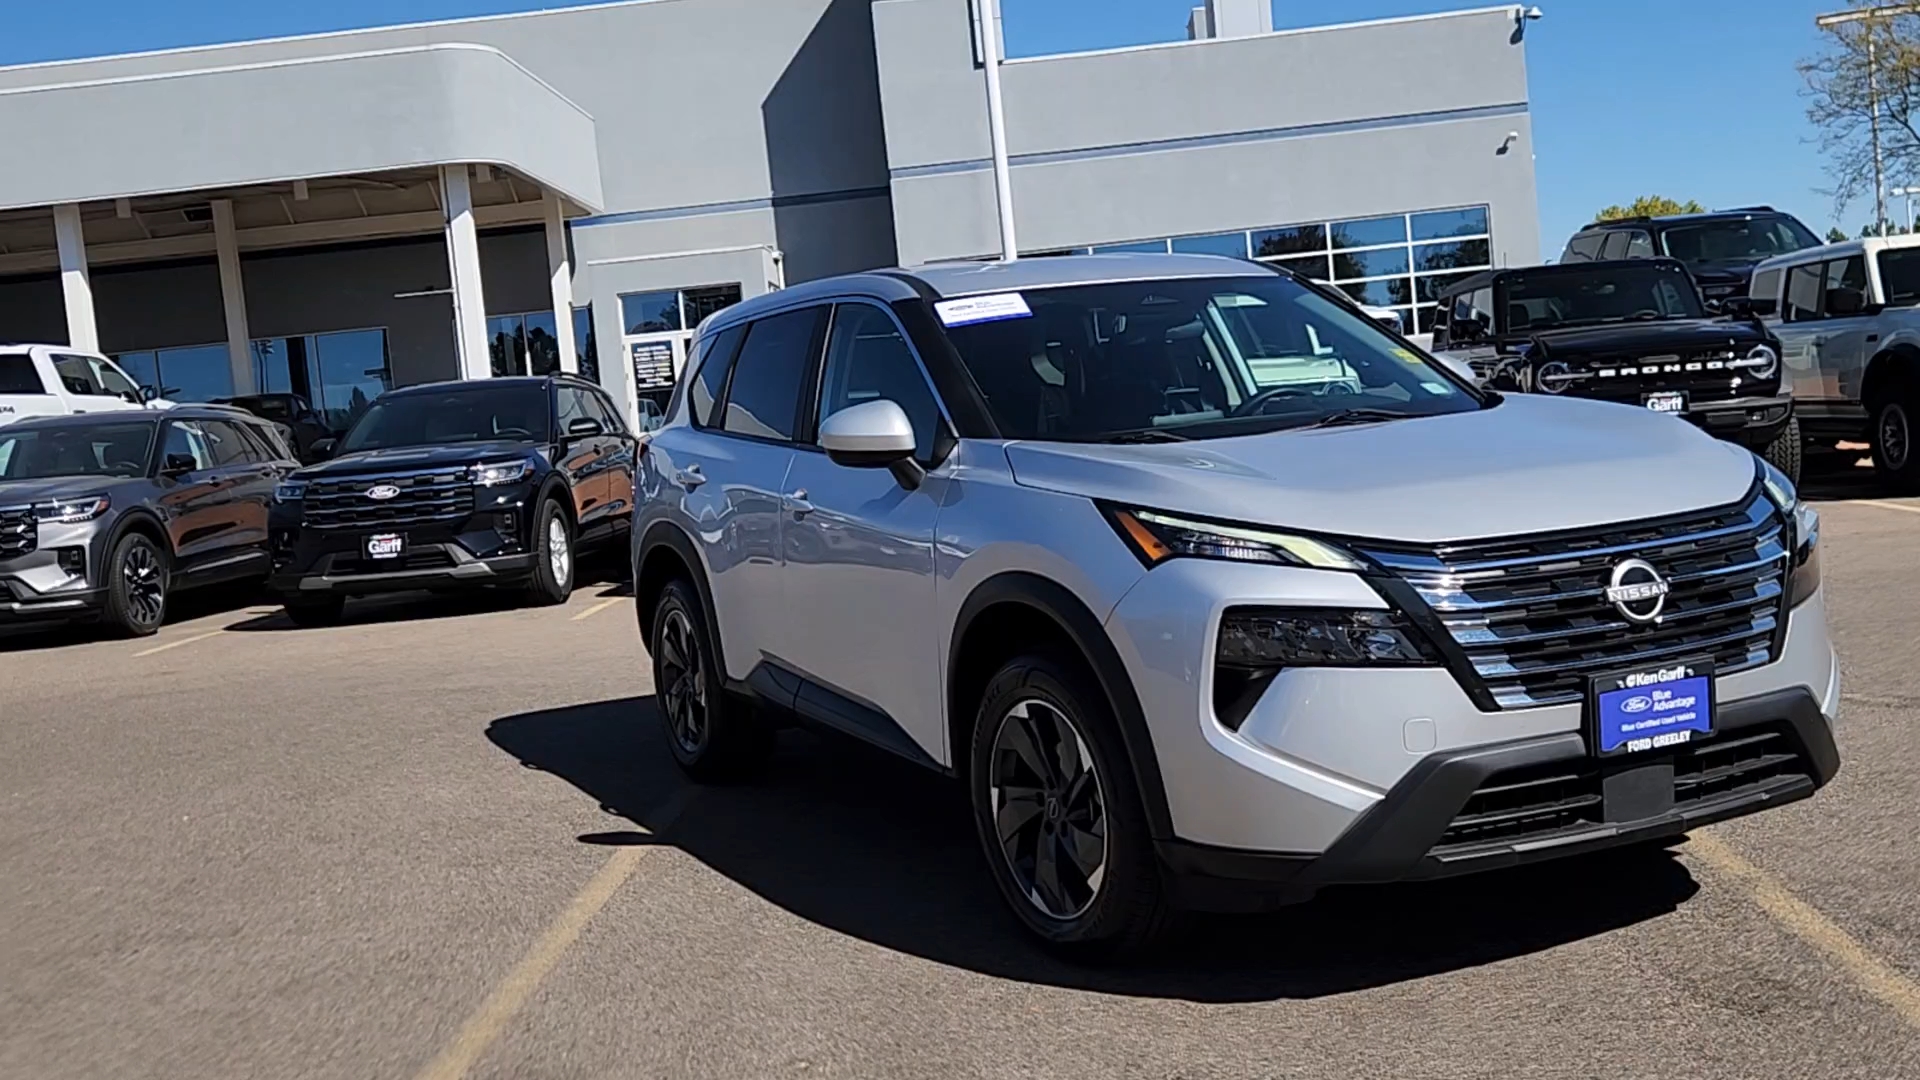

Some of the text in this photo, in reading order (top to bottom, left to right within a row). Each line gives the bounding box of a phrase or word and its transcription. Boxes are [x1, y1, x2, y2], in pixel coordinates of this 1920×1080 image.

[1599, 361, 1723, 377] BRONCO
[1647, 396, 1683, 412] Garff
[368, 538, 402, 554] Garff
[1607, 581, 1669, 602] NISSAN
[1636, 666, 1685, 686] Ken Garff
[1652, 690, 1672, 701] Blue
[1625, 699, 1647, 711] Ford
[1652, 696, 1696, 712] Advantage
[1627, 729, 1691, 753] FORD GREELEY
